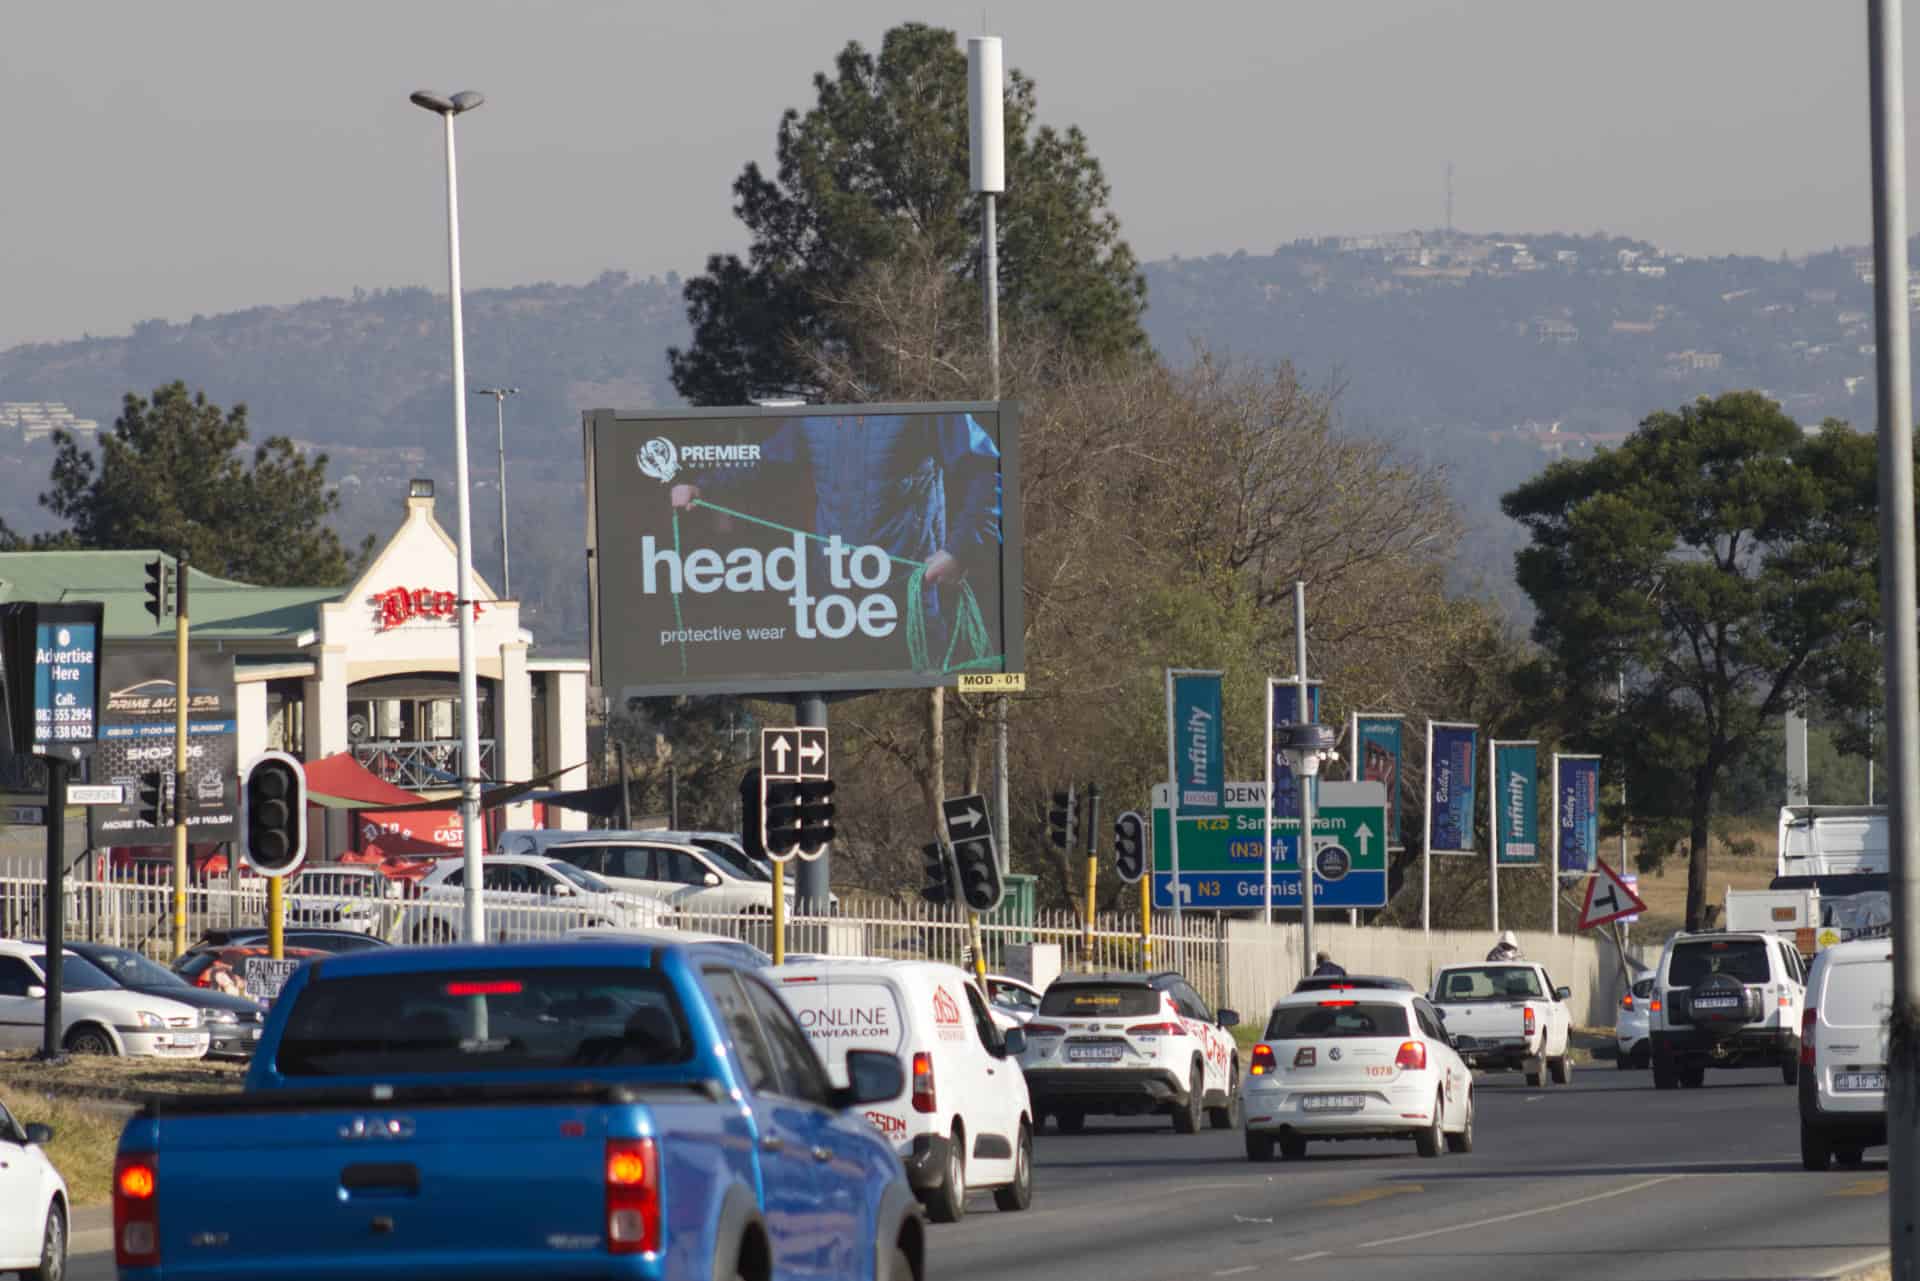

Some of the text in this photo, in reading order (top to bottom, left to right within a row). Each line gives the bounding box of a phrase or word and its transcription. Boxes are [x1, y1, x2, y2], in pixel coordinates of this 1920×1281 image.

[681, 445, 761, 461] PREMIER
[641, 531, 892, 594] head to
[788, 593, 898, 639] toe
[660, 626, 787, 646] protective wear
[36, 648, 94, 664] Advertise
[51, 665, 80, 681] Here
[964, 675, 993, 685] MOD
[1006, 675, 1020, 684] 01
[55, 693, 77, 706] Call:
[107, 697, 152, 711] PRIME
[127, 747, 172, 760] SHOP
[1188, 706, 1212, 785] infinity
[1507, 771, 1528, 837] infinity
[102, 820, 134, 831] MORE
[1197, 814, 1346, 832] R25 Sandrinham
[433, 829, 465, 842] CAST
[1230, 841, 1264, 858] (N3)
[1197, 880, 1324, 897] N3 Germistn
[799, 1007, 888, 1027] ONLINE
[807, 1028, 889, 1039] KWEAR.COM
